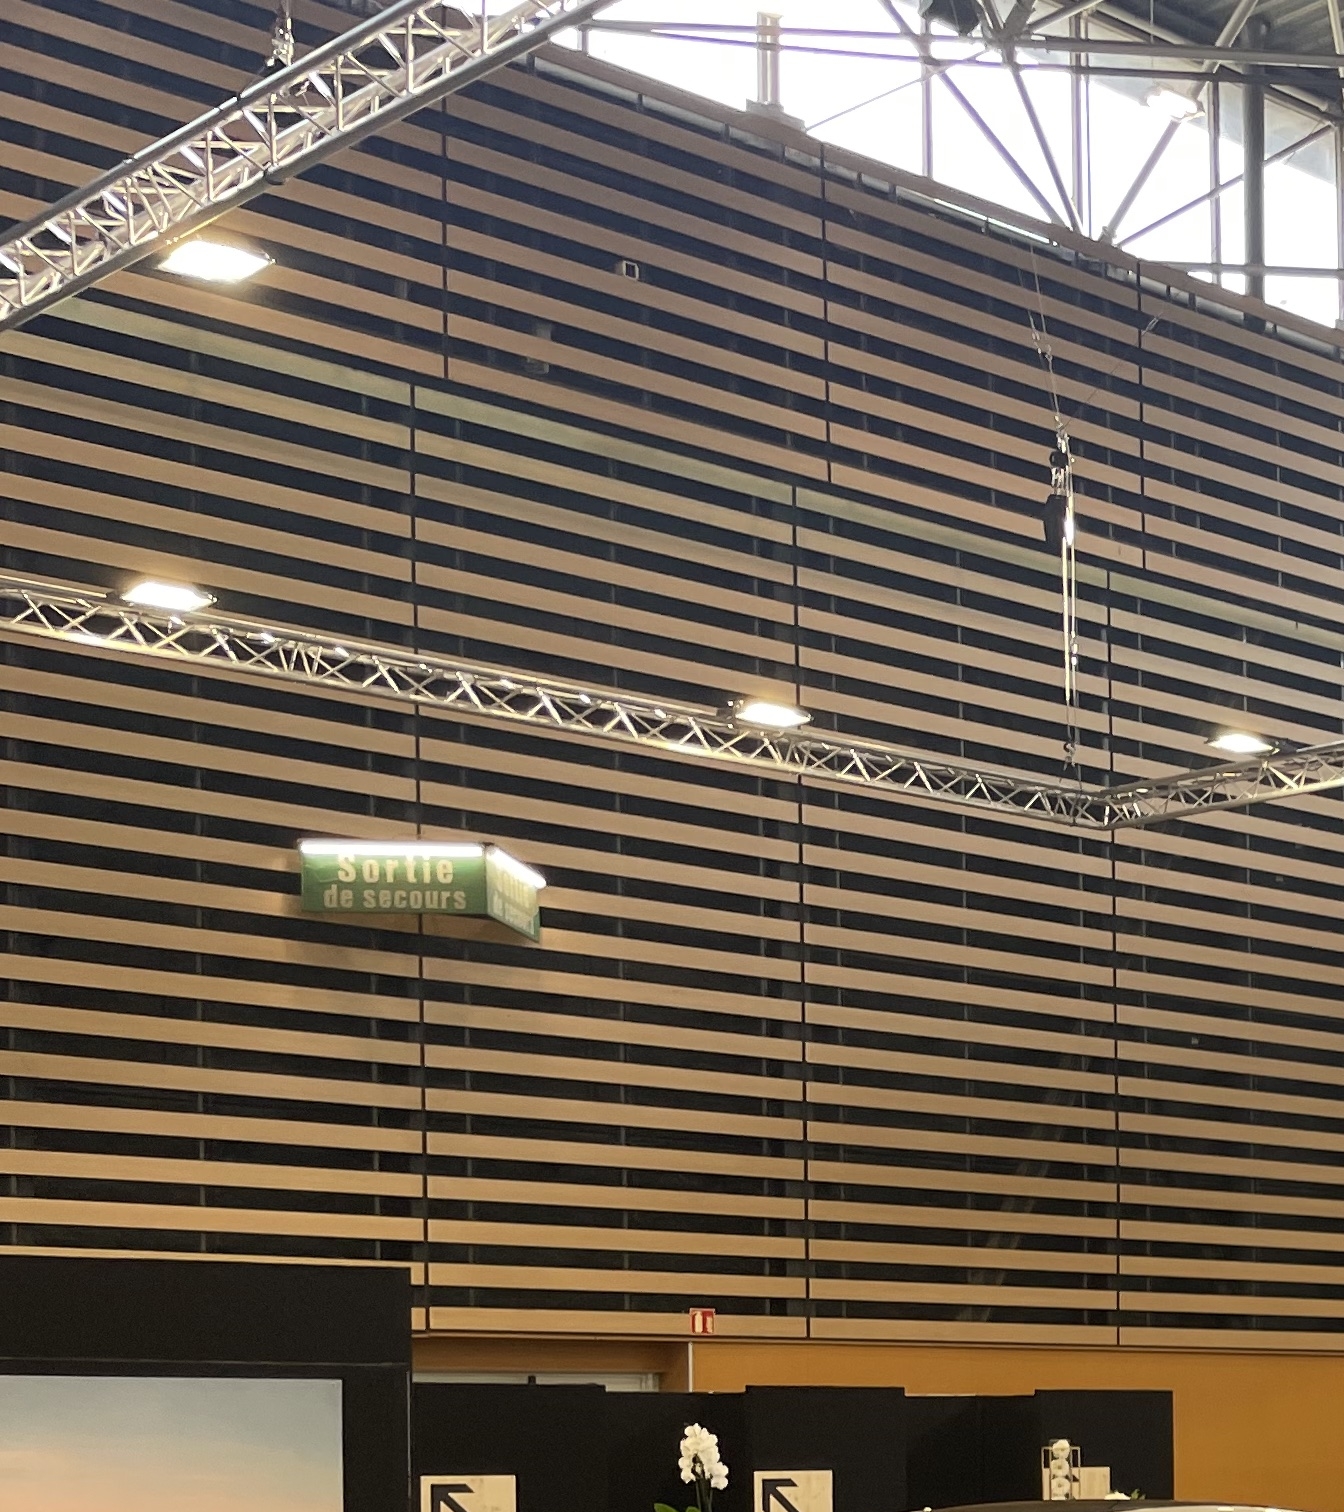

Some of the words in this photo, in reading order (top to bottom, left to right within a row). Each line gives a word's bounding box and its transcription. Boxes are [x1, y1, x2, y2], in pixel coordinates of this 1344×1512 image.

[337, 853, 454, 884] Sortie
[323, 884, 353, 909] de
[362, 885, 466, 910] secours
